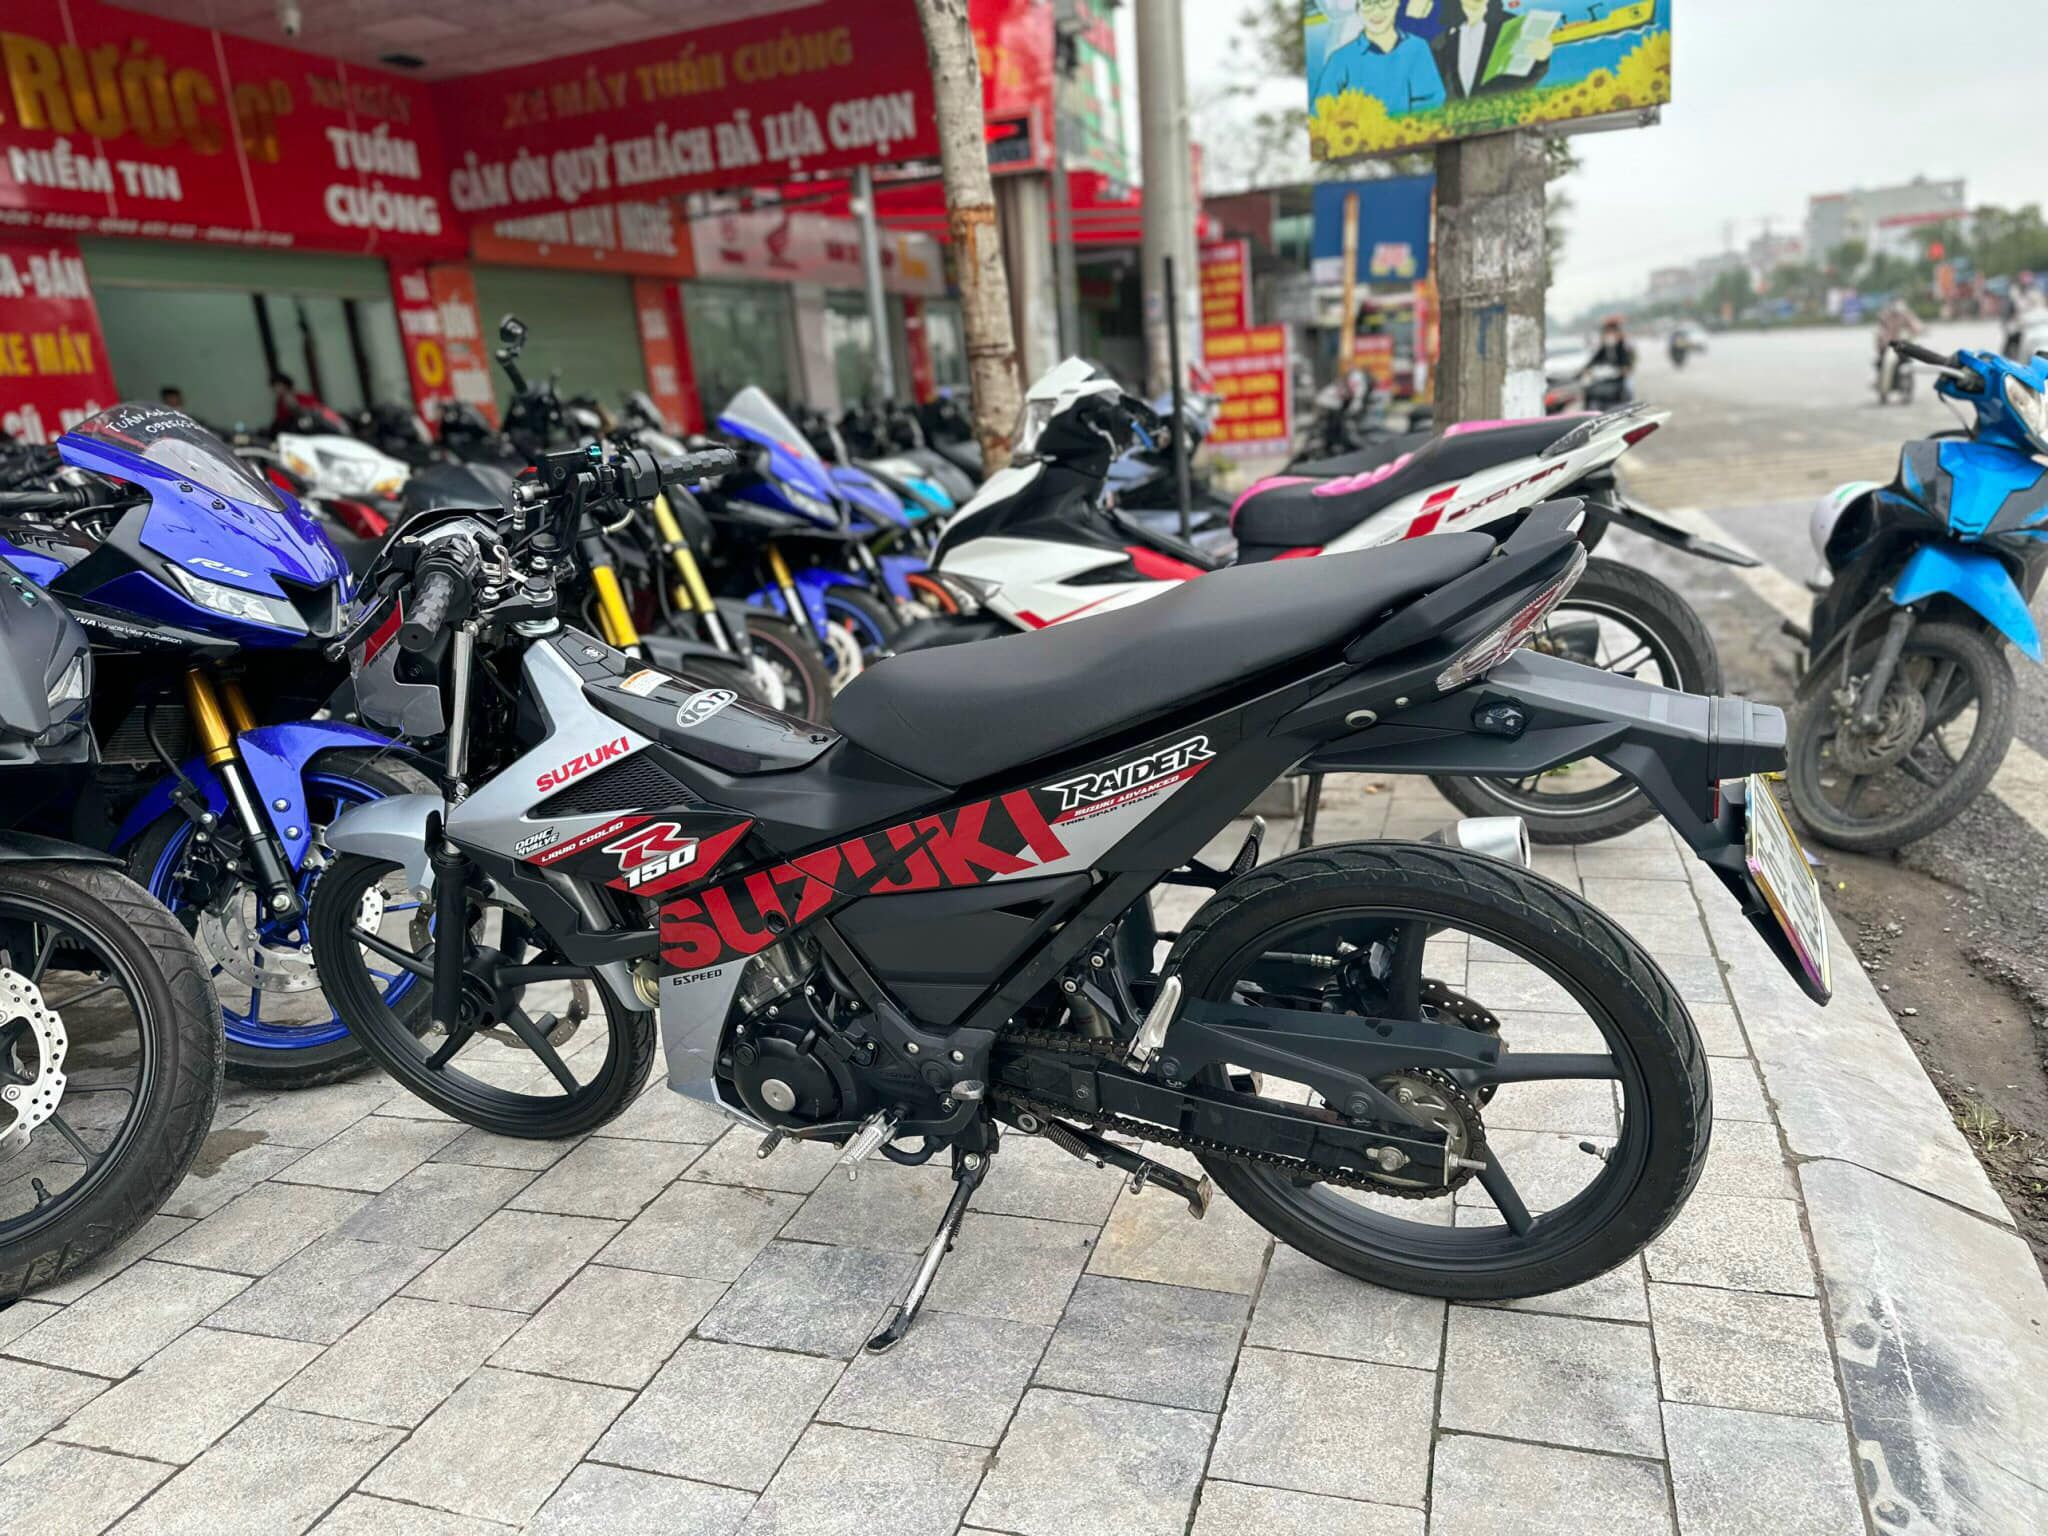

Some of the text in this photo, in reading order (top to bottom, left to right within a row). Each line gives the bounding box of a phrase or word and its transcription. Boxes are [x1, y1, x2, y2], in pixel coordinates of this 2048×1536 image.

[116, 160, 182, 201] TIN
[1446, 461, 1568, 523] EXCITER
[536, 736, 630, 793] SUZUKI
[1041, 735, 1216, 811] RAIDER
[514, 826, 554, 851] DOHC
[542, 821, 624, 863] LIQUID COOLED
[623, 844, 698, 890] 150
[660, 789, 1070, 969] SUZUKI
